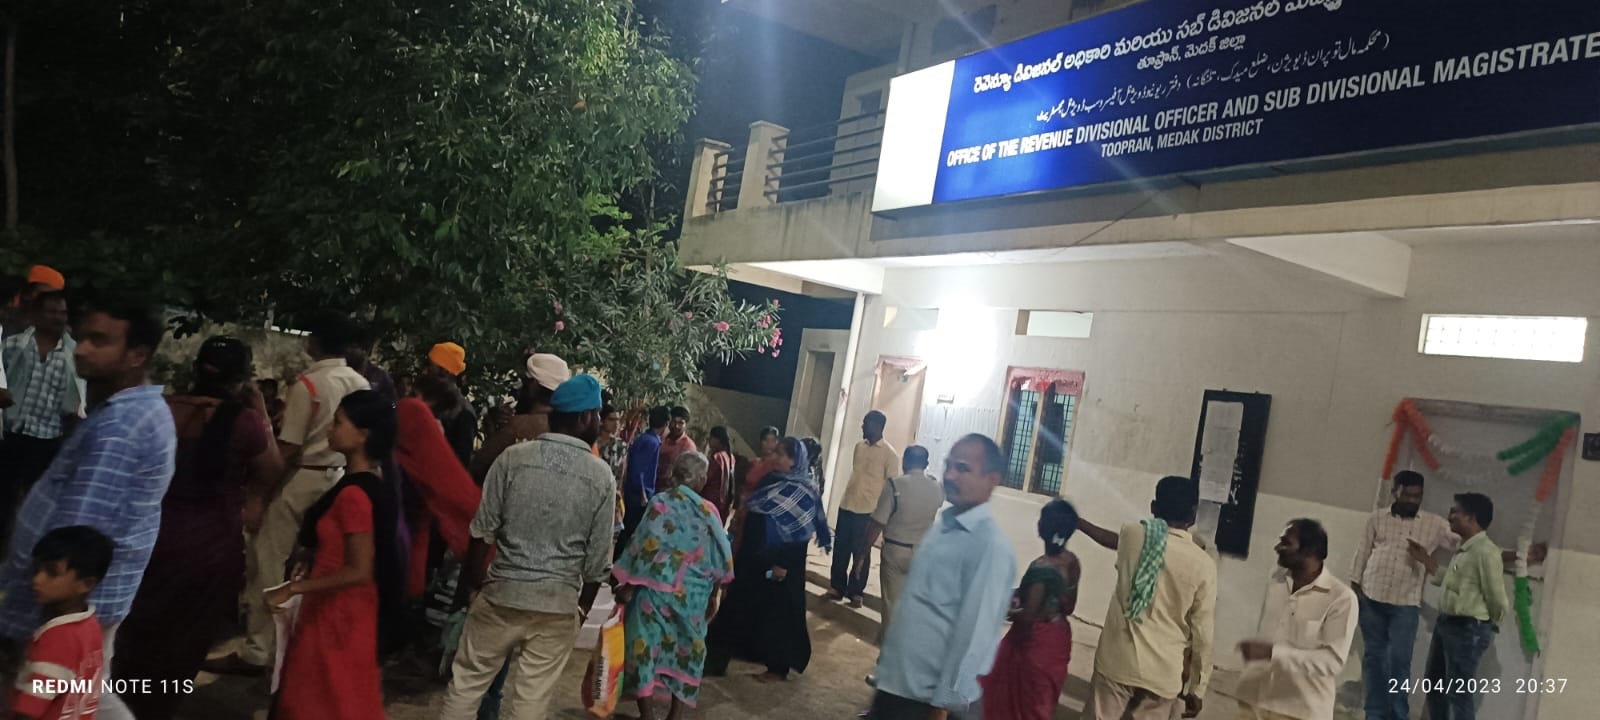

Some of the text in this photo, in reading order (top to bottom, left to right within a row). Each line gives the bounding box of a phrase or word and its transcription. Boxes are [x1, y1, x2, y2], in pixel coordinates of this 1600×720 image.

[1064, 44, 1111, 70] అధికారి
[1114, 27, 1173, 57] మరియు
[1175, 13, 1206, 40] సబ్
[1184, 35, 1218, 59] మెదక్
[1219, 35, 1246, 52] జిల్లా
[946, 31, 1600, 167] OFFICE OF THE REVENUE DIVISIONAL OFFICER AND SUB DIVISIONAL MAGISTRATE
[1101, 118, 1264, 158] TOOPRAN, MEDAK DISTRICT
